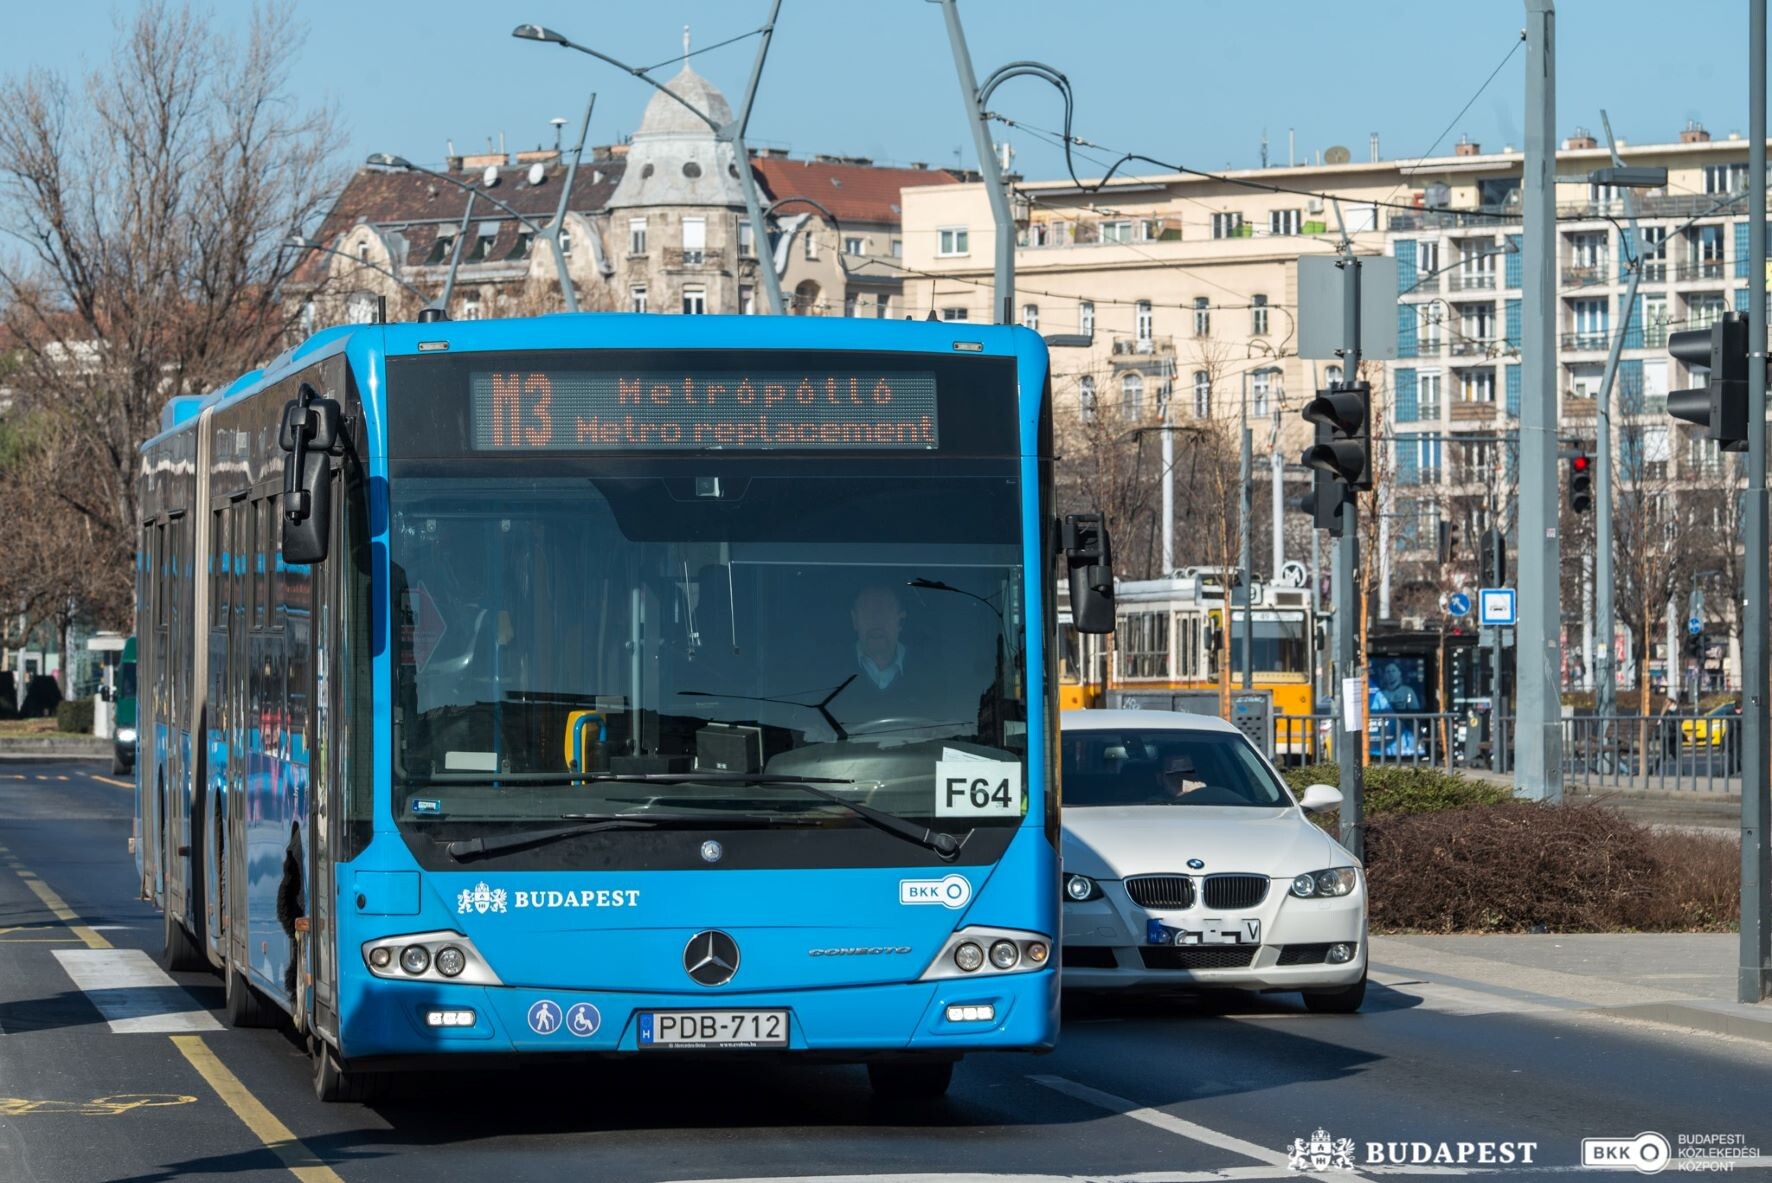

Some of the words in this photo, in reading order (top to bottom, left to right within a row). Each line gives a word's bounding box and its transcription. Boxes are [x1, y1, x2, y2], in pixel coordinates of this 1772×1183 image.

[619, 377, 892, 407] Metrópótló
[492, 374, 553, 446] M3
[577, 415, 681, 442] Metro
[697, 415, 934, 445] replacement
[946, 778, 1012, 808] F64
[515, 890, 640, 908] BUDAPEST
[909, 887, 939, 897] BKK
[808, 946, 912, 957] CONECTO
[643, 1030, 650, 1039] H
[660, 1015, 780, 1039] PDB-712
